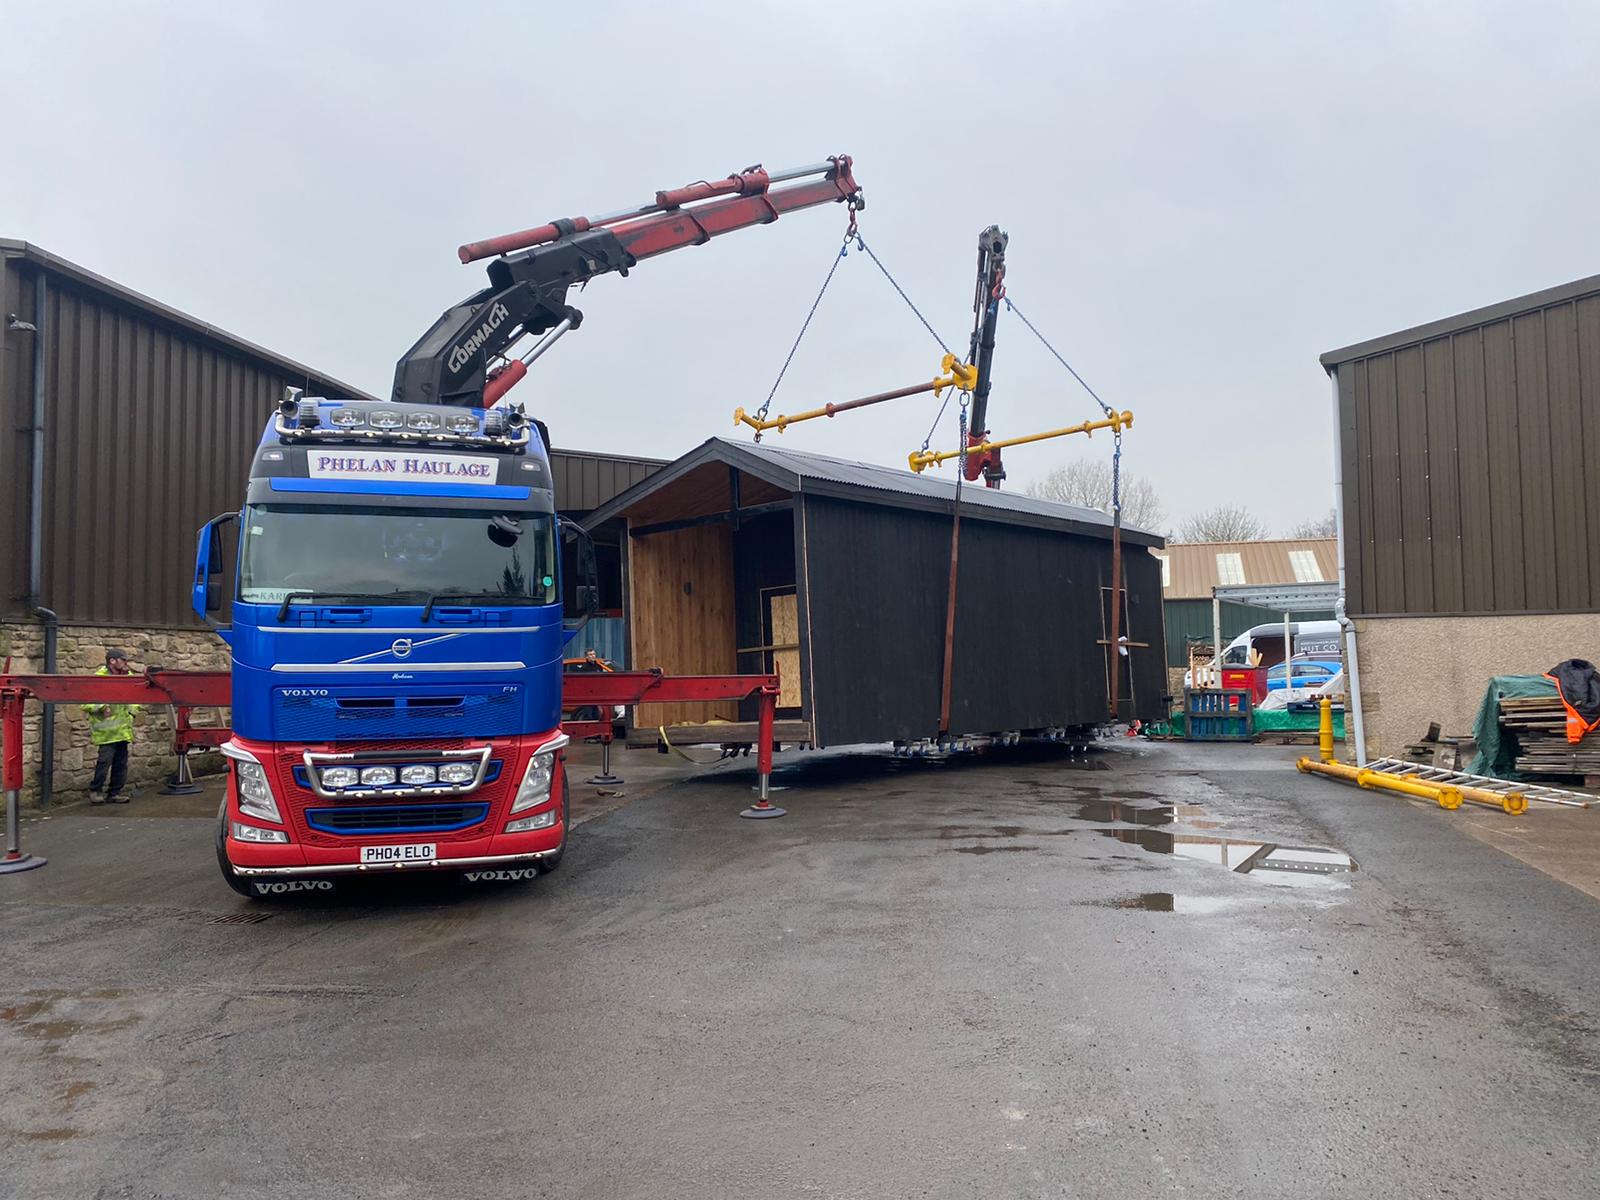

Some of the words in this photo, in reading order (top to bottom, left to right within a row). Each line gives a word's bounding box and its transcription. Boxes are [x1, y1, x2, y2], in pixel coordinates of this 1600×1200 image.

[317, 456, 397, 473] PHELAN
[402, 458, 491, 478] HAULAGE
[281, 688, 329, 697] VOLVO
[366, 847, 401, 861] PH04
[464, 868, 537, 882] VOLVO
[254, 881, 333, 894] VOLVO
